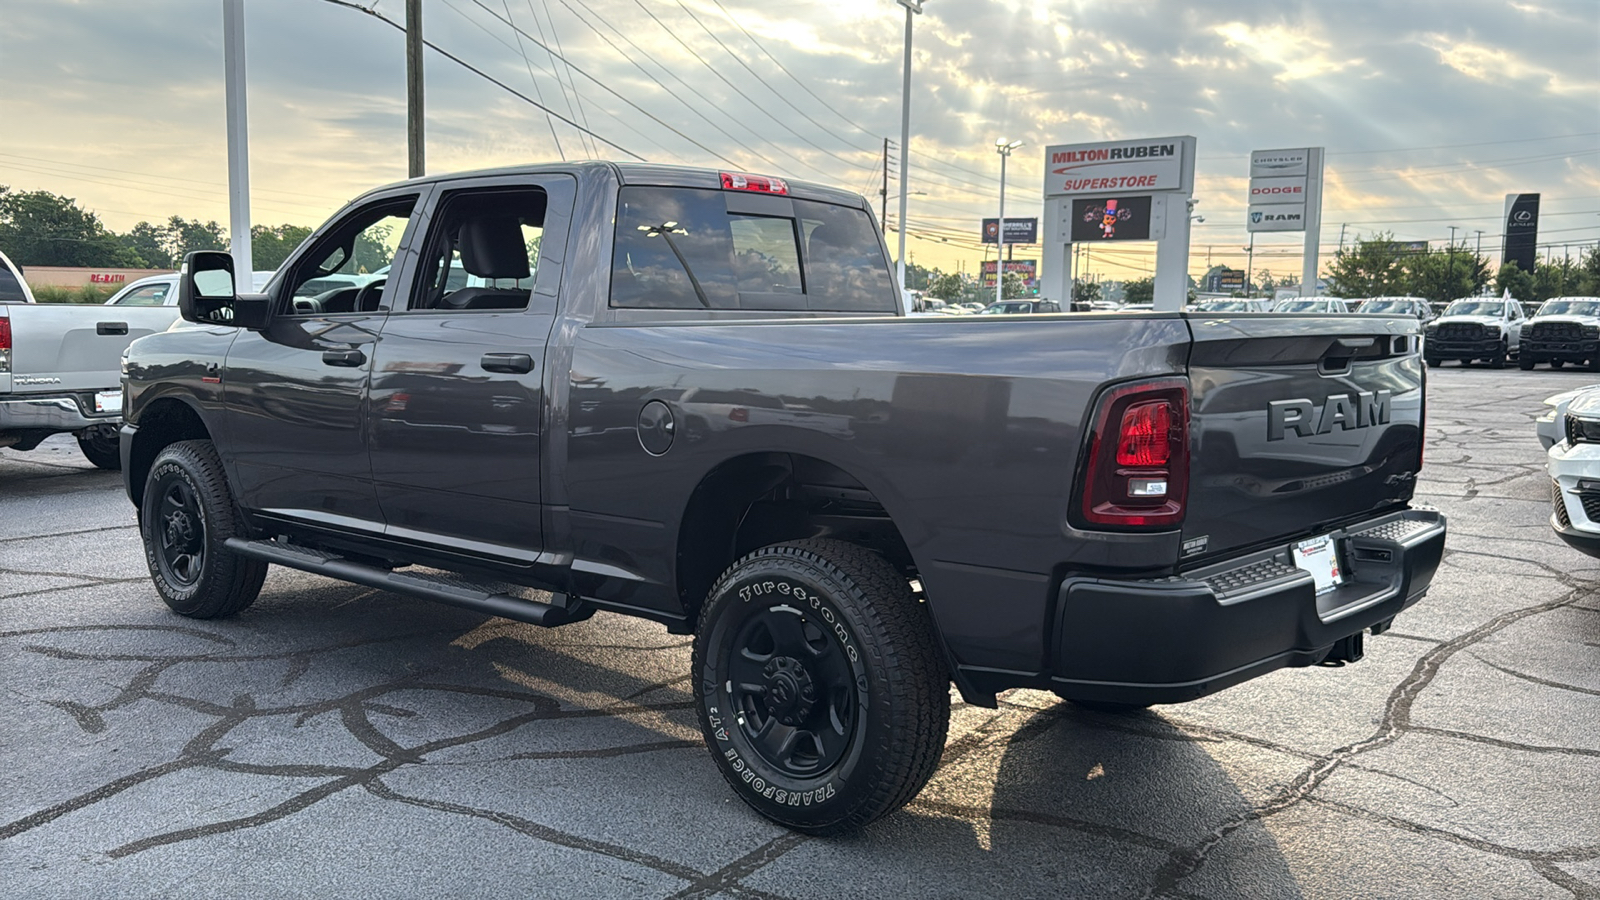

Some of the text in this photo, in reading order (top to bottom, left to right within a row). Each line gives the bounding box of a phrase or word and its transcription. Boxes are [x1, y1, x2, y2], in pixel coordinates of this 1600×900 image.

[1052, 144, 1175, 164] MILTON RUBEN
[1254, 156, 1303, 164] CHRYSLER
[1063, 174, 1158, 191] SUPERSTORE
[1251, 186, 1302, 195] DODGE
[1264, 213, 1301, 221] RAM
[14, 377, 61, 386] TUNDRA
[1266, 389, 1392, 442] RAM
[739, 581, 859, 663] Firestone
[724, 750, 836, 807] TRANSFORCE
